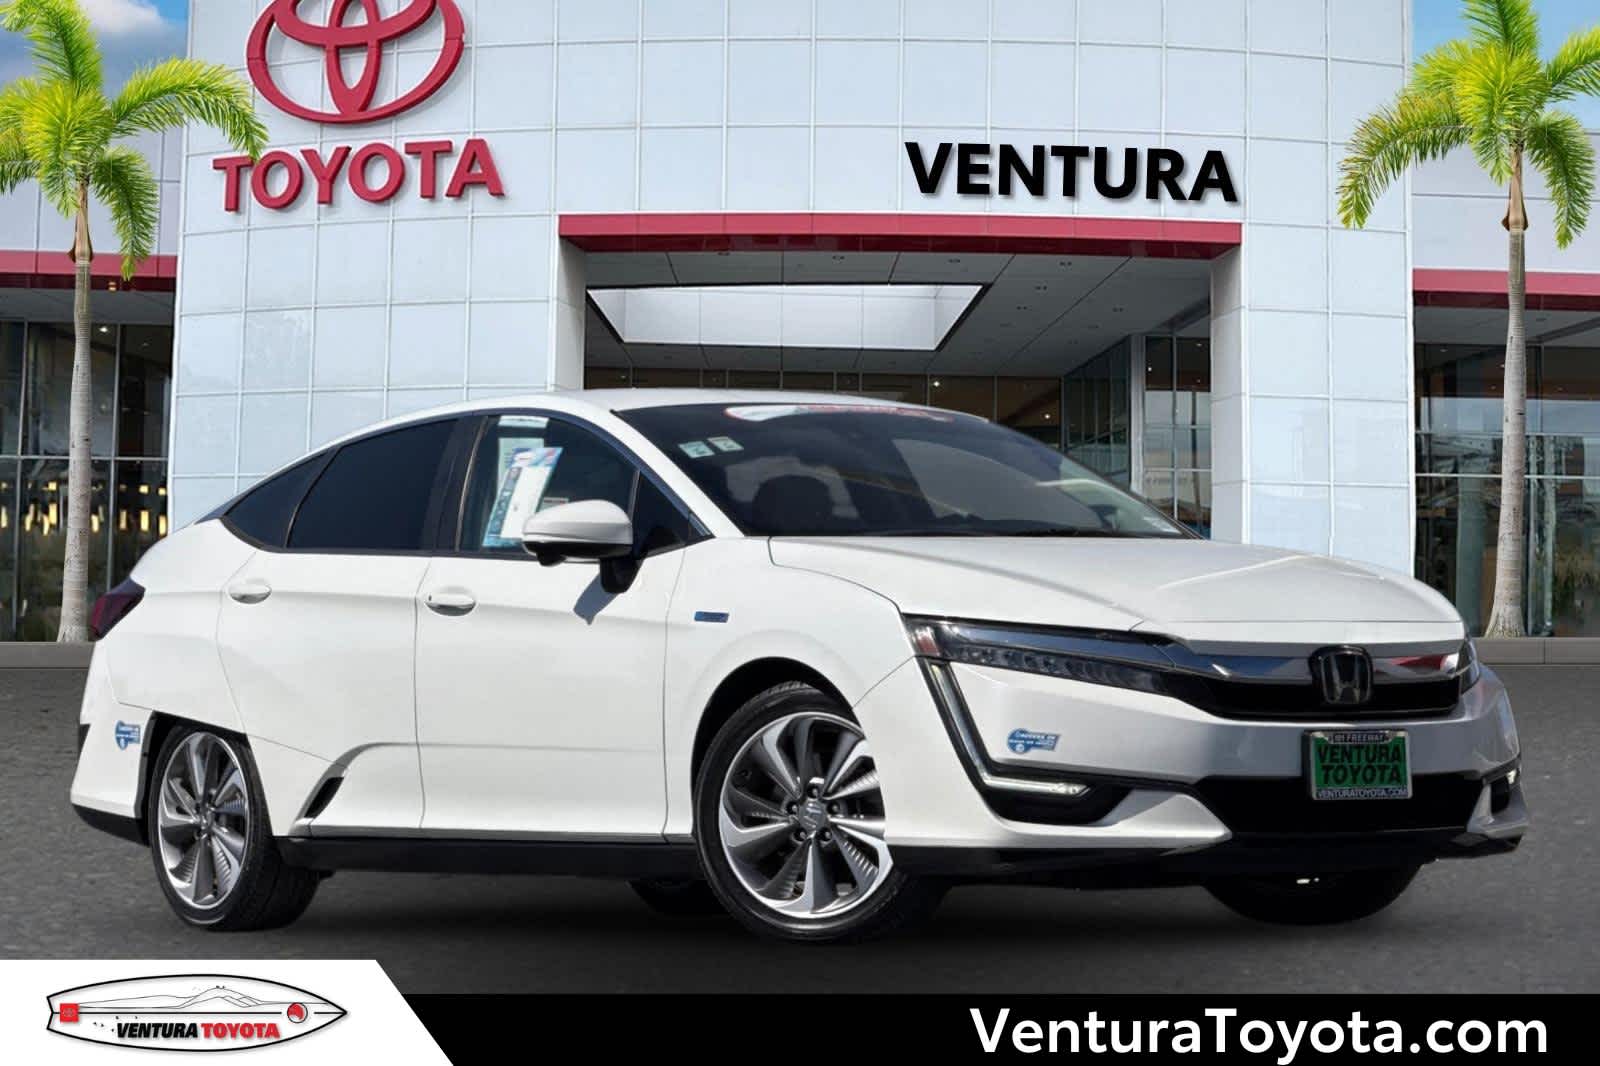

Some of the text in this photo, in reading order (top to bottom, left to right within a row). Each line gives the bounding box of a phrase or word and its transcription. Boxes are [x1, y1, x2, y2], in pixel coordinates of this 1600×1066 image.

[212, 138, 505, 212] TOYOTA
[905, 141, 1239, 202] VENTURA
[1317, 744, 1402, 763] VENTURA
[1320, 764, 1402, 785] TOYOTA
[1318, 787, 1409, 799] VENTURATOYOTA.COM
